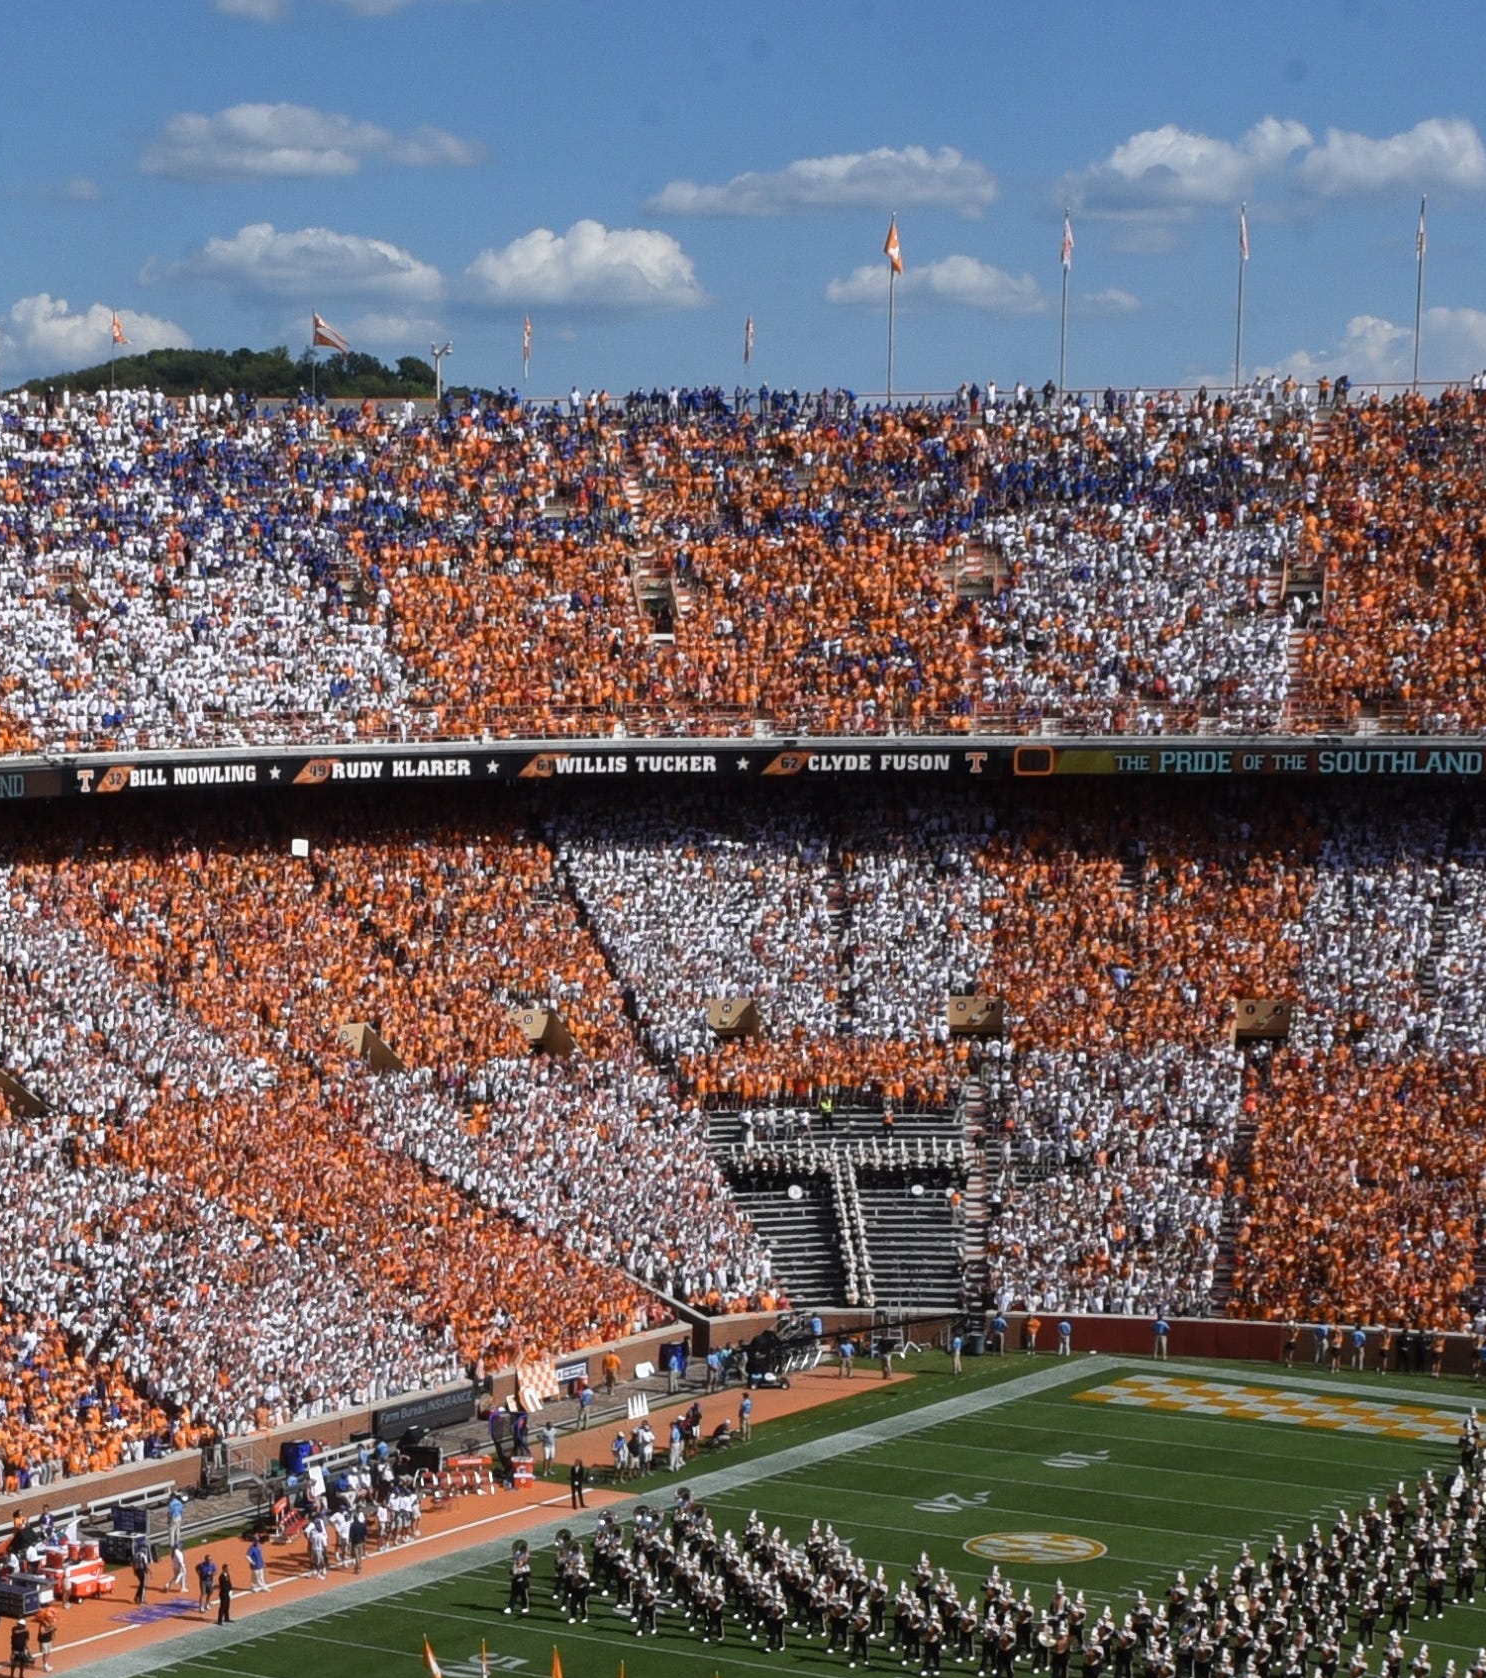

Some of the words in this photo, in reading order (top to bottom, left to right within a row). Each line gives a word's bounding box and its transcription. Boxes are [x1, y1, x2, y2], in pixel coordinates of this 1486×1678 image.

[331, 761, 383, 779] RUDY
[392, 759, 471, 777] KLARER
[555, 756, 627, 774] WILLIS
[635, 755, 717, 772] TUCKER
[807, 754, 872, 771] CLYDE
[880, 754, 951, 771] FUSON
[1114, 754, 1150, 771] THE
[1158, 751, 1233, 774] PRIDE
[1242, 754, 1266, 770] OF
[1271, 754, 1307, 771] THE
[1318, 751, 1483, 774] SOUTHLAND
[130, 768, 167, 787] BILL
[173, 765, 256, 786] NOWLING
[380, 1411, 401, 1424] Farm
[403, 1405, 426, 1419] Bureau
[428, 1390, 473, 1411] INSURANCE
